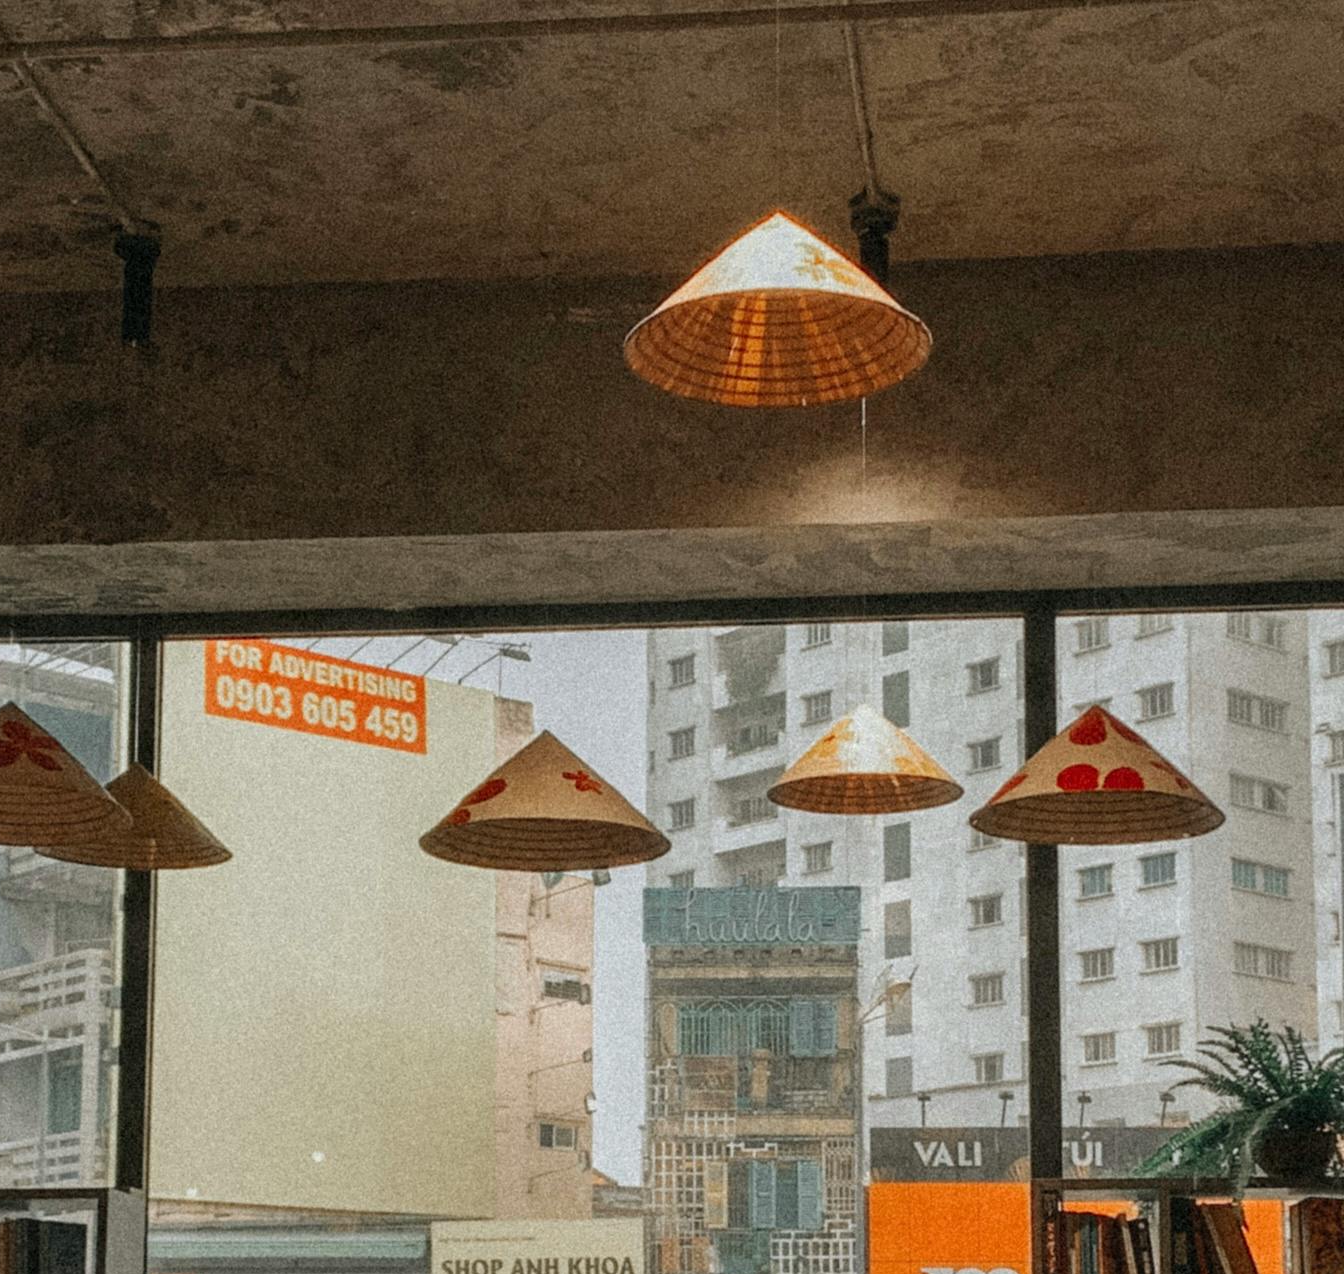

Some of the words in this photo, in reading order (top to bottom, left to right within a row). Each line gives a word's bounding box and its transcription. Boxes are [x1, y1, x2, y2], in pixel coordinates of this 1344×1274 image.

[215, 640, 263, 671] FOR
[268, 651, 417, 702] ADVERTISING
[216, 675, 293, 719] 0903
[302, 692, 357, 732] 605
[365, 705, 419, 743] 459
[913, 1140, 982, 1167] VALI
